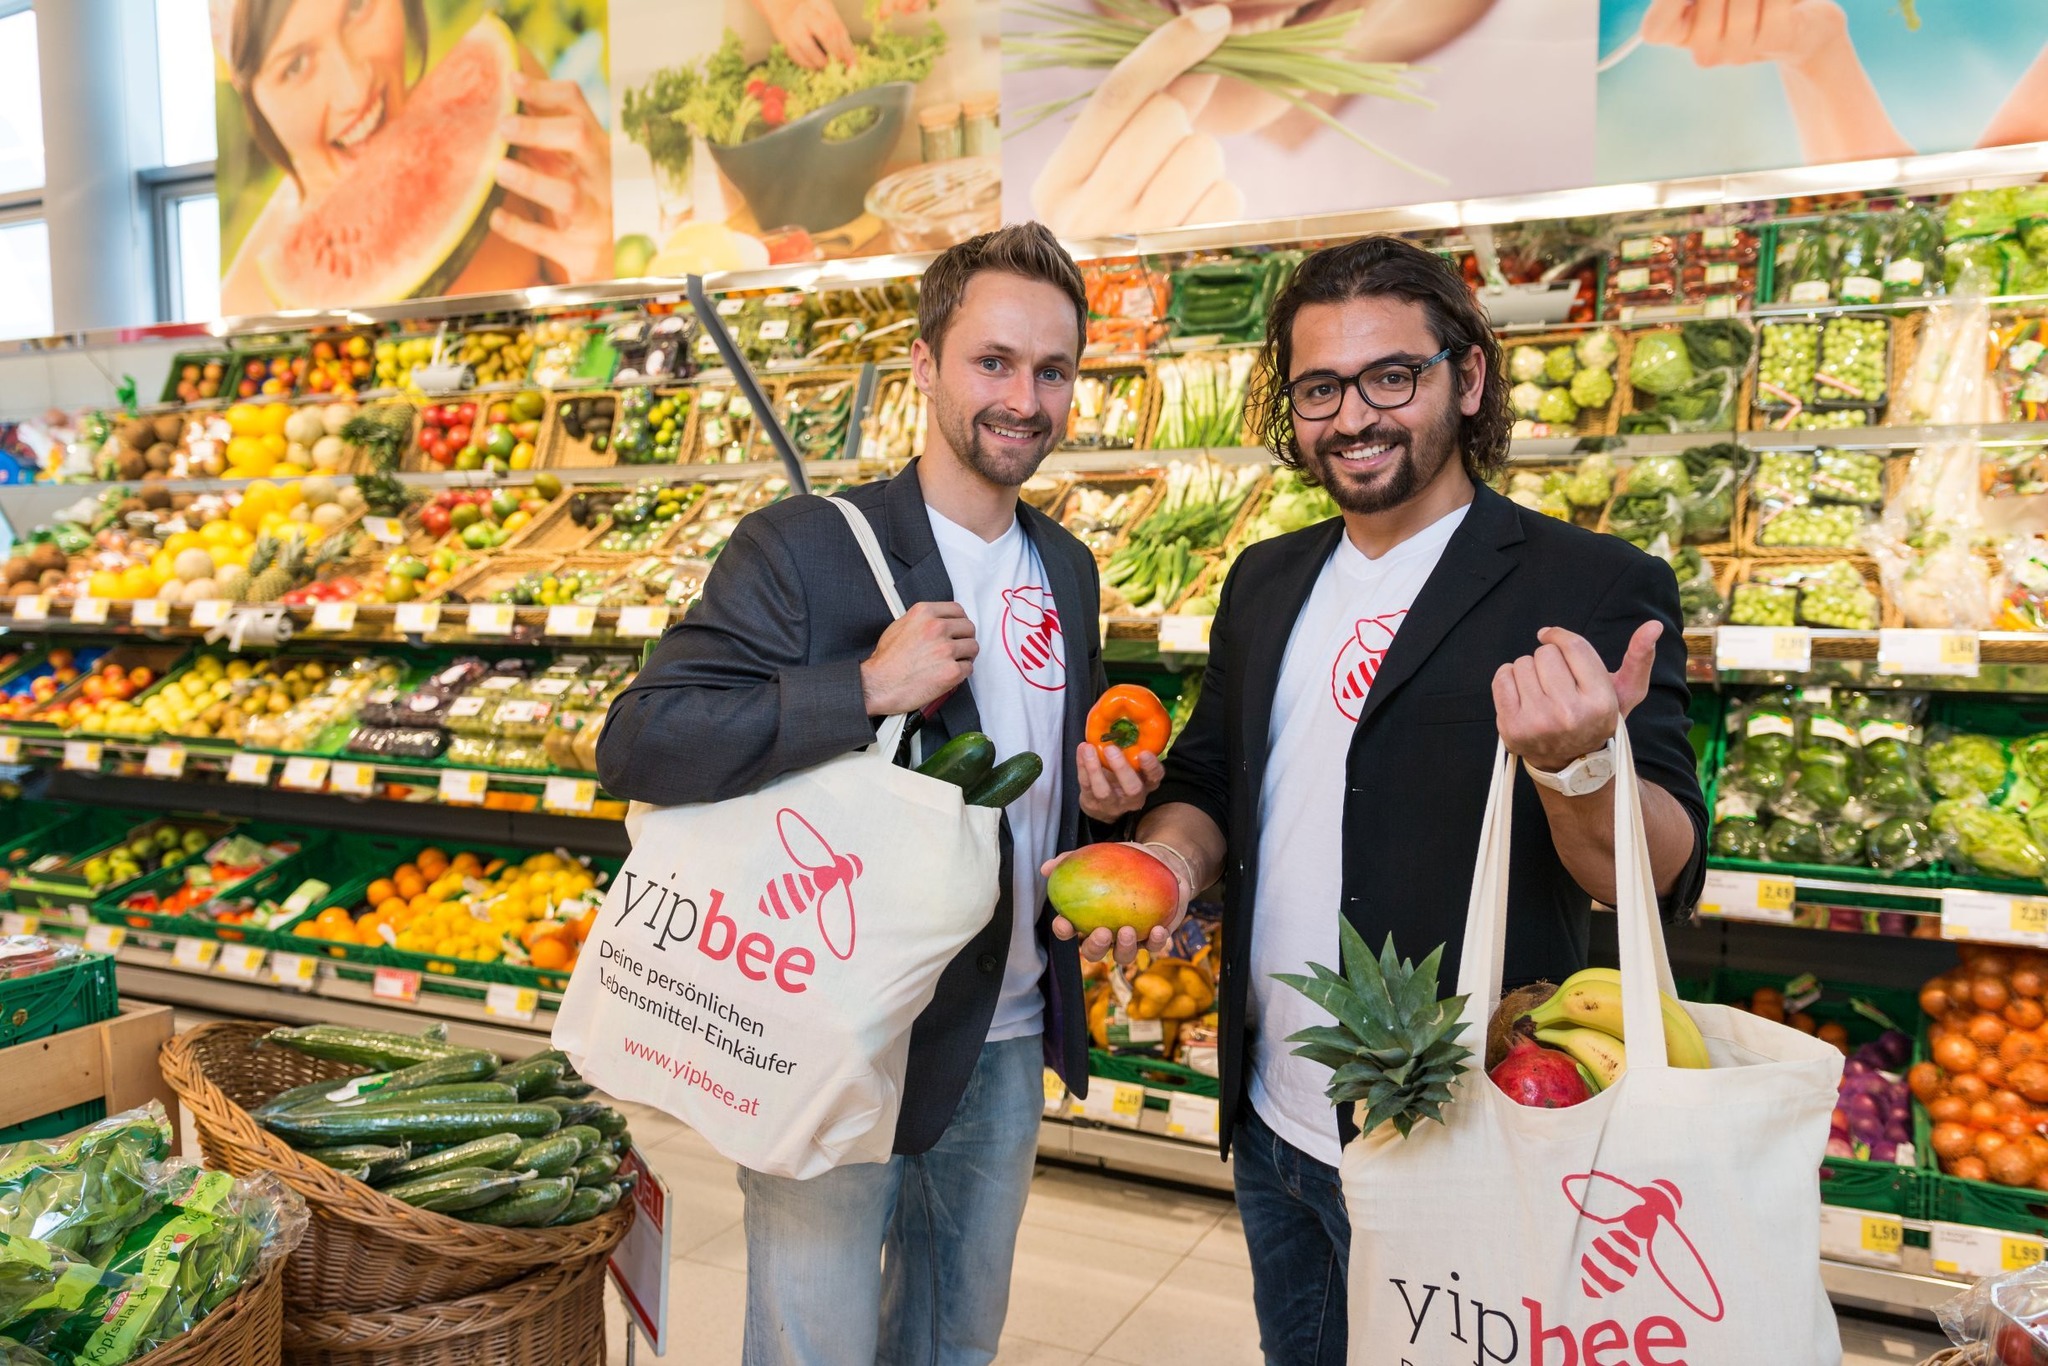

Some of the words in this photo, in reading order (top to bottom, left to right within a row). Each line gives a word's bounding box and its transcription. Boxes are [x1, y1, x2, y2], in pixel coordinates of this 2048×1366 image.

[614, 870, 816, 994] yipbee
[600, 939, 643, 977] Deine
[646, 967, 764, 1038] persönlichen
[600, 966, 797, 1075] Lebensmittel-Einkäufer
[624, 1037, 760, 1117] www.yipbee.at
[148, 1233, 175, 1277] Italien
[88, 1303, 138, 1363] Kopfsalat
[1388, 1271, 1689, 1366] yipbee
